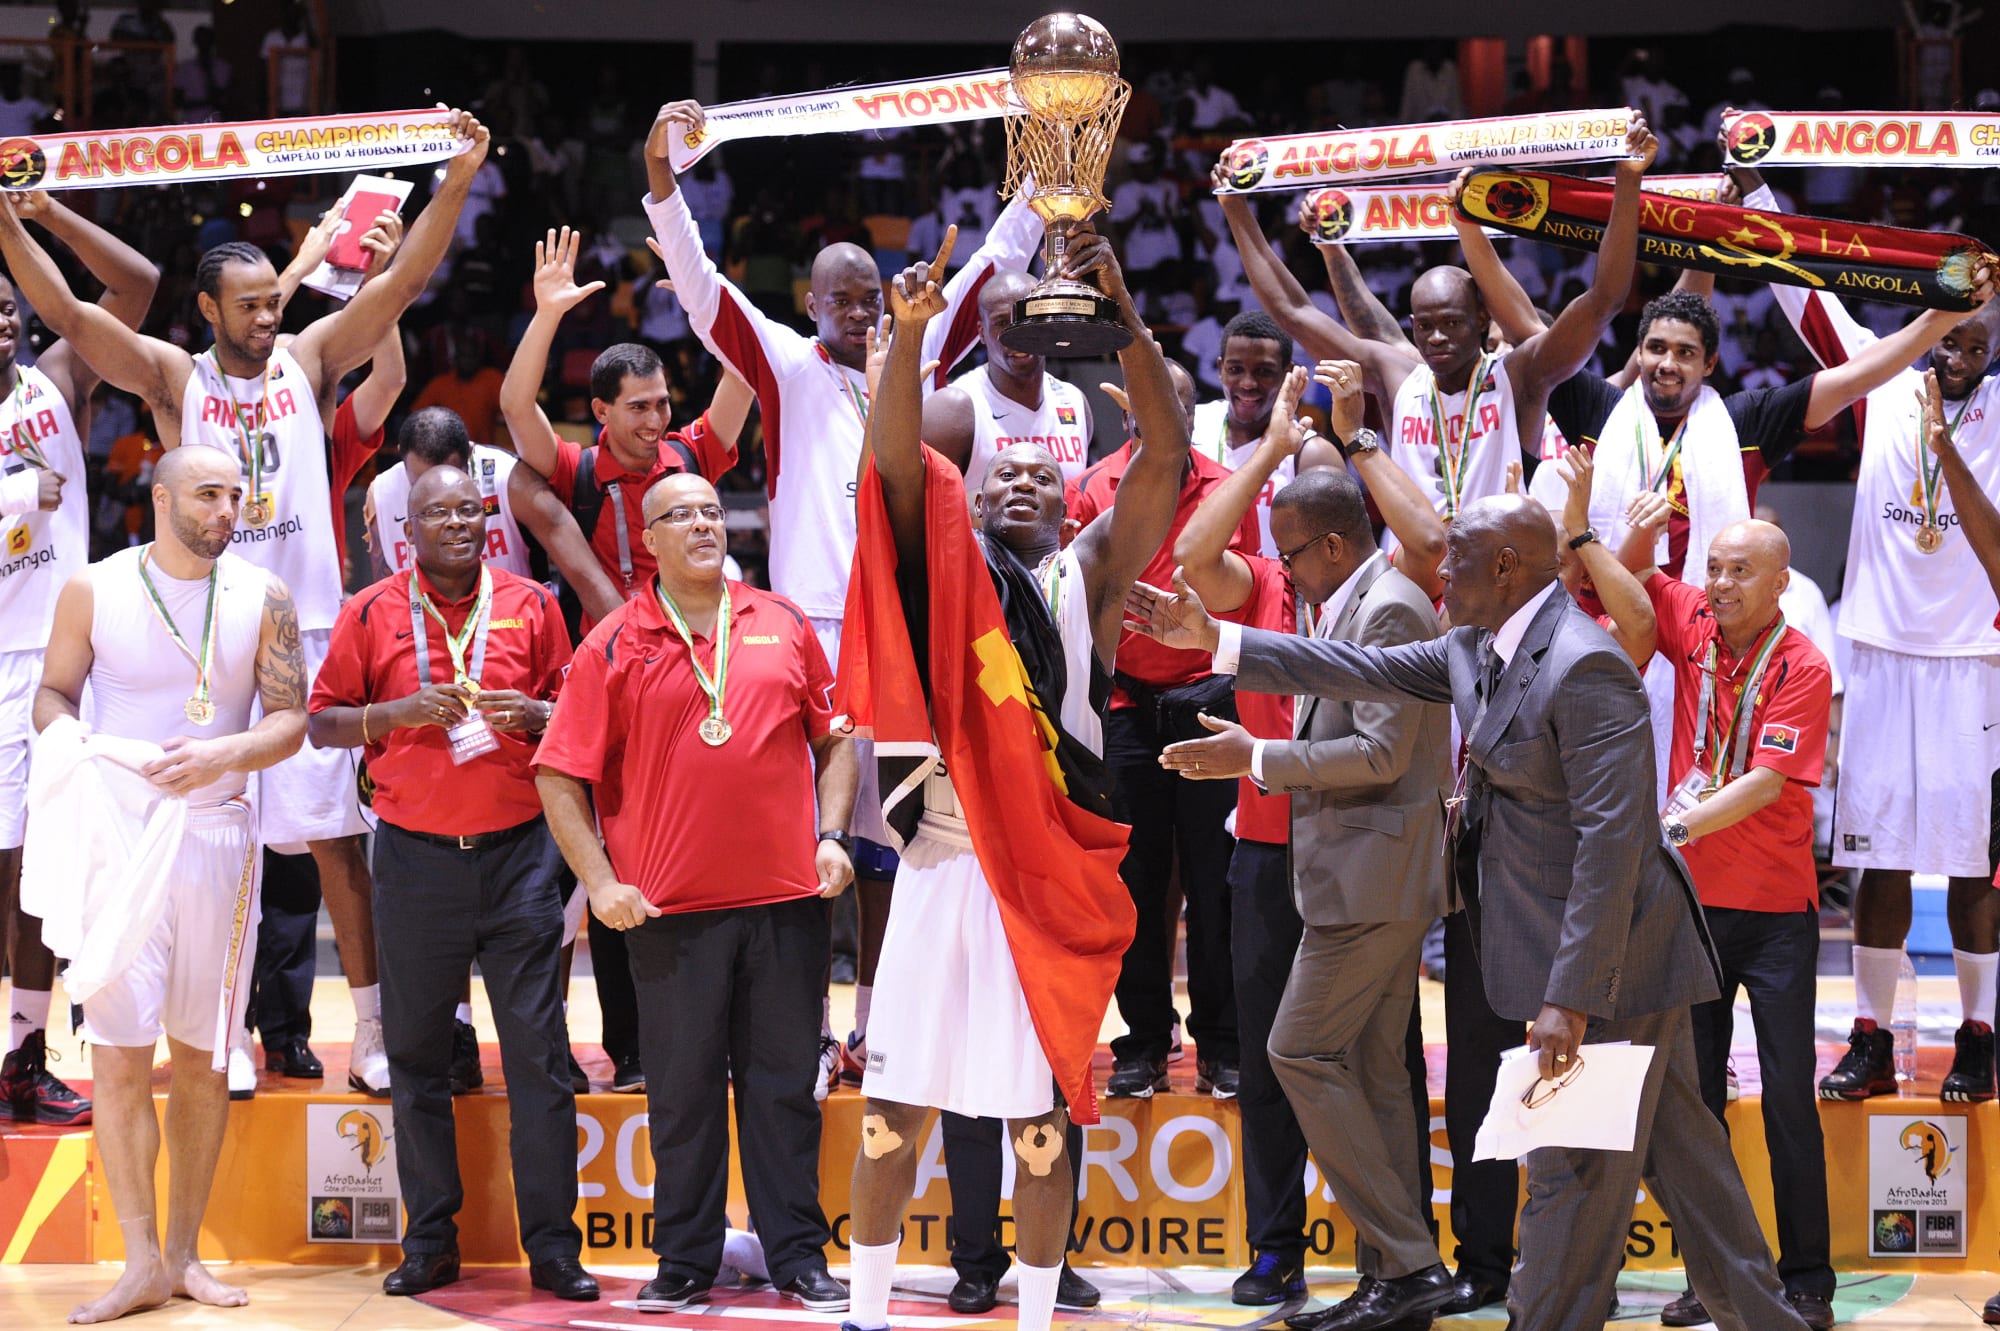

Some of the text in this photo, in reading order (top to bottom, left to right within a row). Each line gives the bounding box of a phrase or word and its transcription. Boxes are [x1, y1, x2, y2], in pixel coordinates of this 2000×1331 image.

[853, 79, 1009, 120] ANGOLA
[255, 123, 399, 153] CHAMPION
[1445, 118, 1628, 150] CHAMPION 2013
[1501, 147, 1516, 157] DO
[1519, 140, 1586, 154] AFROBASKET
[1590, 138, 1618, 149] 2013
[1781, 120, 1960, 157] ANGOLA
[57, 131, 250, 180] ANGOLA
[324, 150, 341, 159] DO
[345, 143, 418, 157] AFROBASKET
[422, 141, 453, 152] 2013
[1273, 131, 1438, 178] ANGOLA
[1362, 193, 1450, 231] ANG
[1642, 199, 1697, 233] NG
[1545, 221, 1924, 296] NINGU PARA ANGOLA
[995, 436, 1084, 463] AOLA
[231, 514, 303, 544] onangol
[1882, 502, 1960, 531] Sonago
[0, 544, 57, 578] nangol
[488, 618, 525, 630] ANGOLA
[742, 634, 780, 646] ANGOLA
[324, 1173, 383, 1186] AfroBasket
[1887, 1187, 1947, 1198] AfroBasket
[362, 1202, 390, 1217] FIBA
[1886, 1198, 1902, 1206] Côte
[1925, 1215, 1955, 1231] FIBA
[1928, 1230, 1953, 1240] AFRICA
